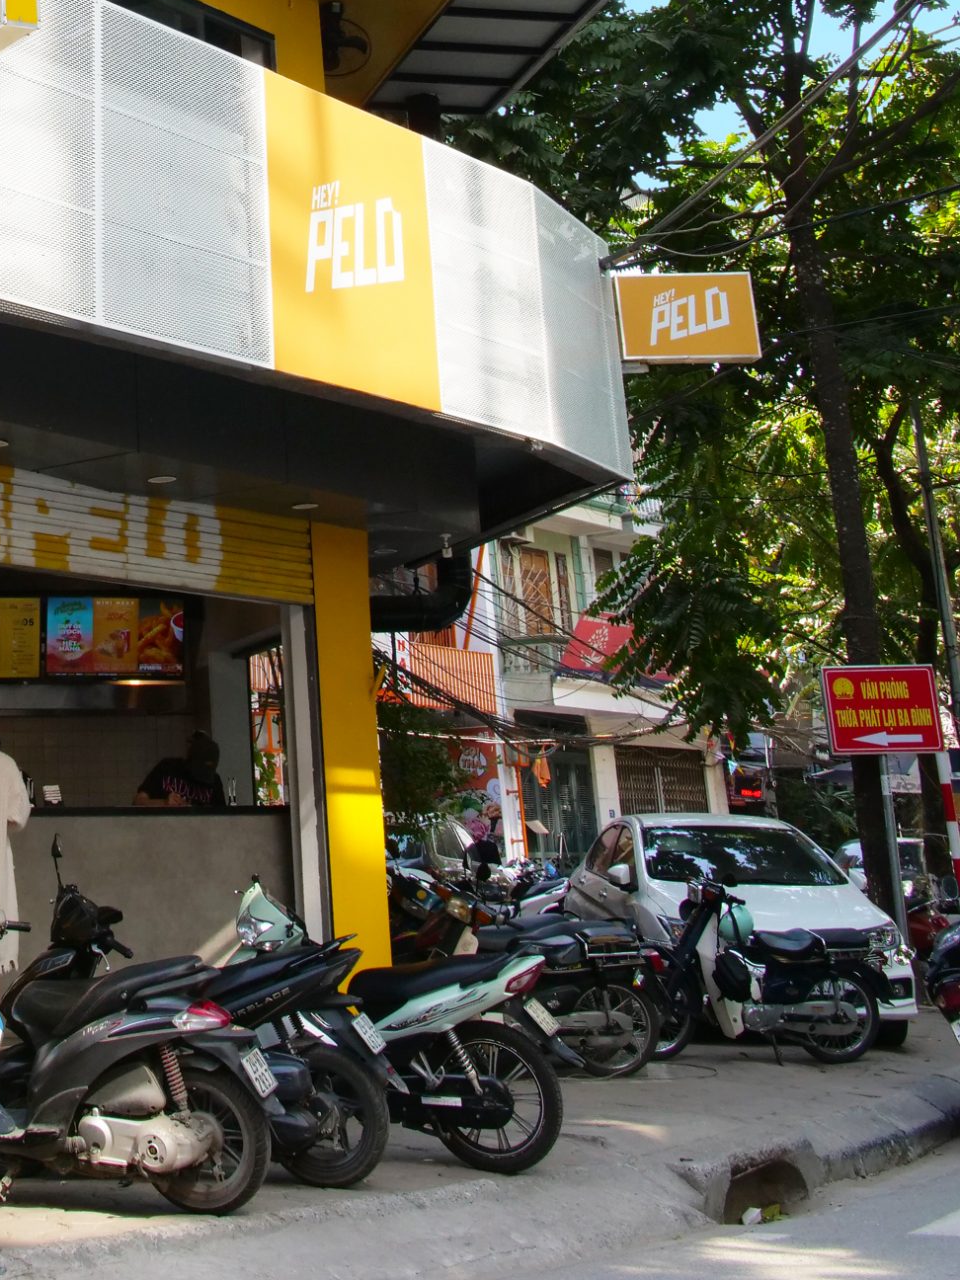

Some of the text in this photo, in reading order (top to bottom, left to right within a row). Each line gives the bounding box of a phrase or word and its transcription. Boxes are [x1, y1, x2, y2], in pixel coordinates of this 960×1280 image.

[311, 179, 340, 211] HEY!
[304, 196, 405, 294] PELO
[653, 288, 676, 308] HEY!
[649, 286, 730, 347] PELO
[10, 468, 223, 592] PELO
[860, 677, 910, 700] VĂN PHÒNG
[835, 705, 933, 731] THỪA PHÁT LẠI BA ĐÌNH
[231, 986, 291, 1020] IRBLADE
